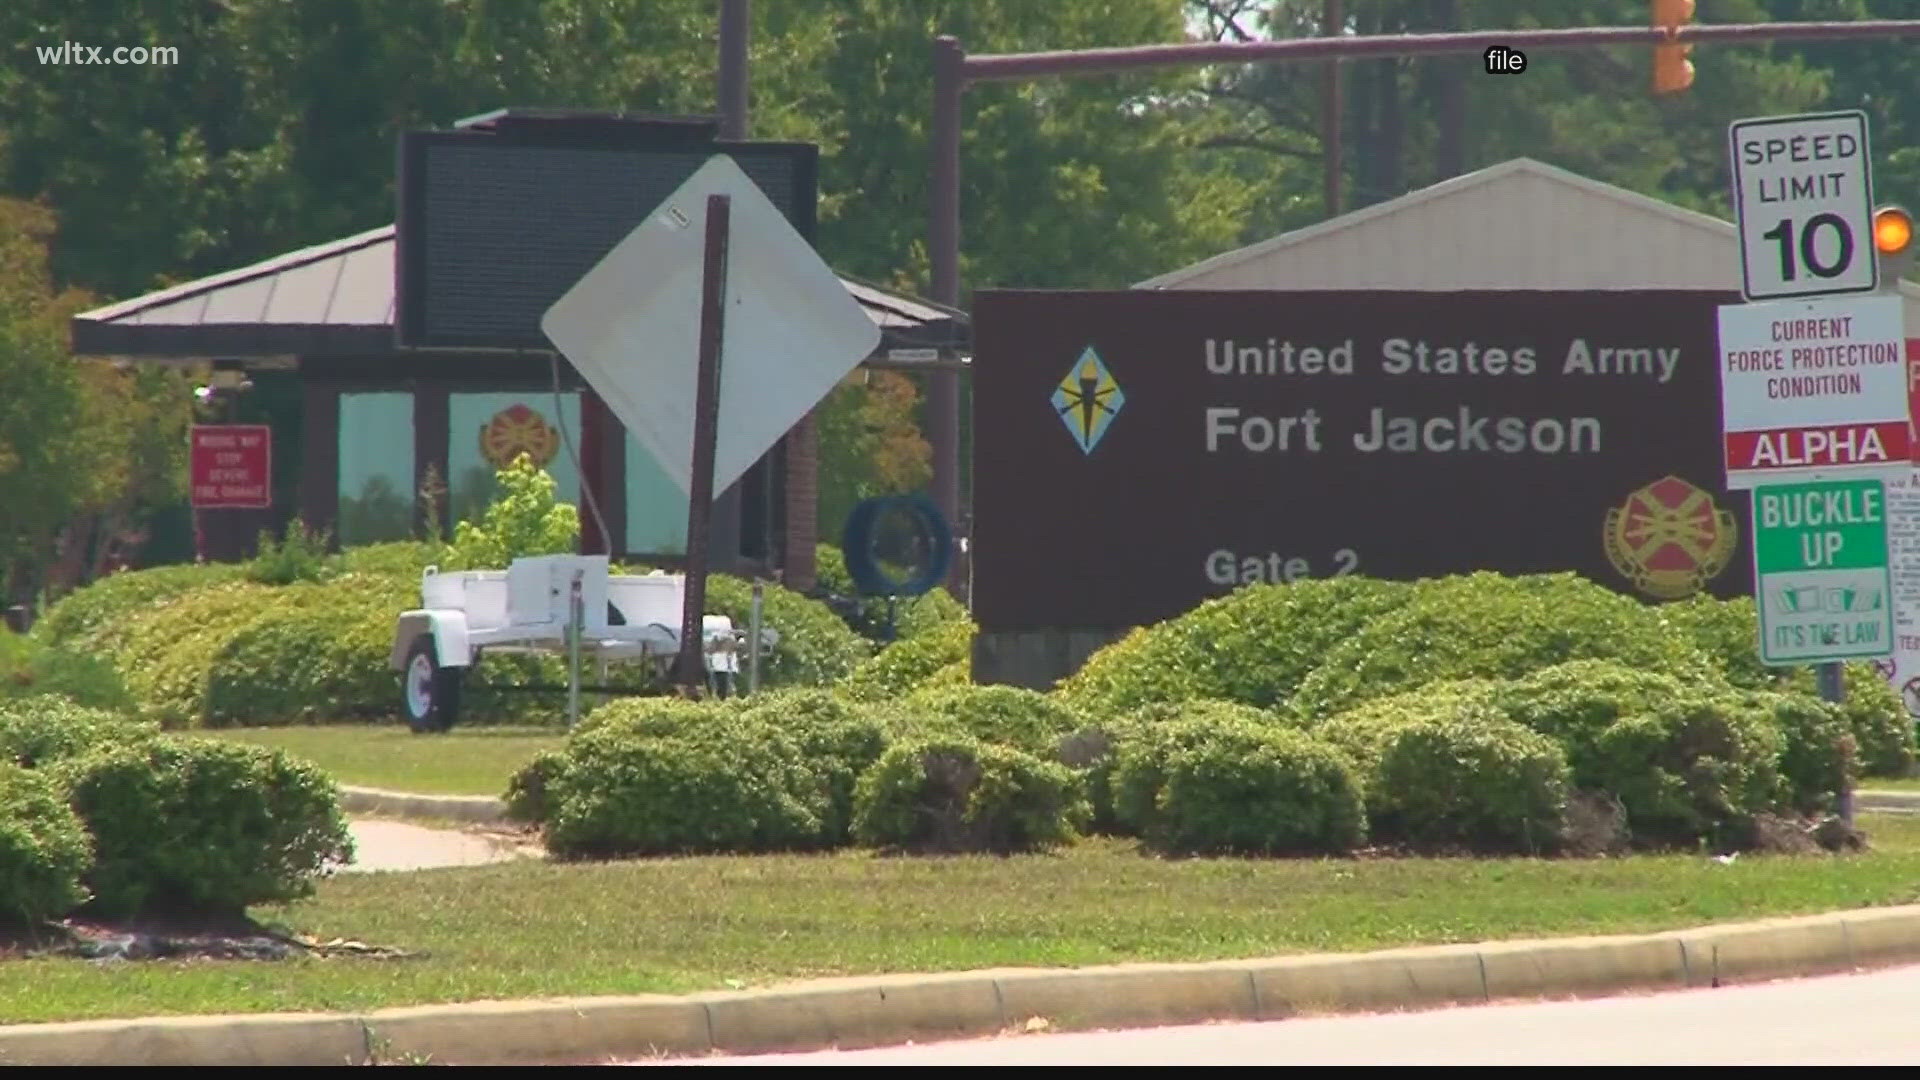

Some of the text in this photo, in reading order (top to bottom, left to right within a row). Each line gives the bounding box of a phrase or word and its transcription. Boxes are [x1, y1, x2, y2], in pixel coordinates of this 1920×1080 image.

[1744, 133, 1857, 165] SPEED
[1760, 172, 1845, 203] LIMIT
[1763, 212, 1855, 282] 10
[1771, 317, 1853, 342] CURRENT
[1205, 338, 1681, 384] United States Army
[1727, 342, 1899, 373] FORCE PROTECTION
[1767, 372, 1862, 399] CONDITION
[1206, 404, 1602, 454] Fort Jackson
[1751, 427, 1888, 467] ALPHA
[1761, 488, 1881, 529] BUCKLE
[1206, 549, 1310, 584] Gate
[1801, 531, 1844, 567] UP
[1775, 620, 1881, 648] IT'S THE LAW
